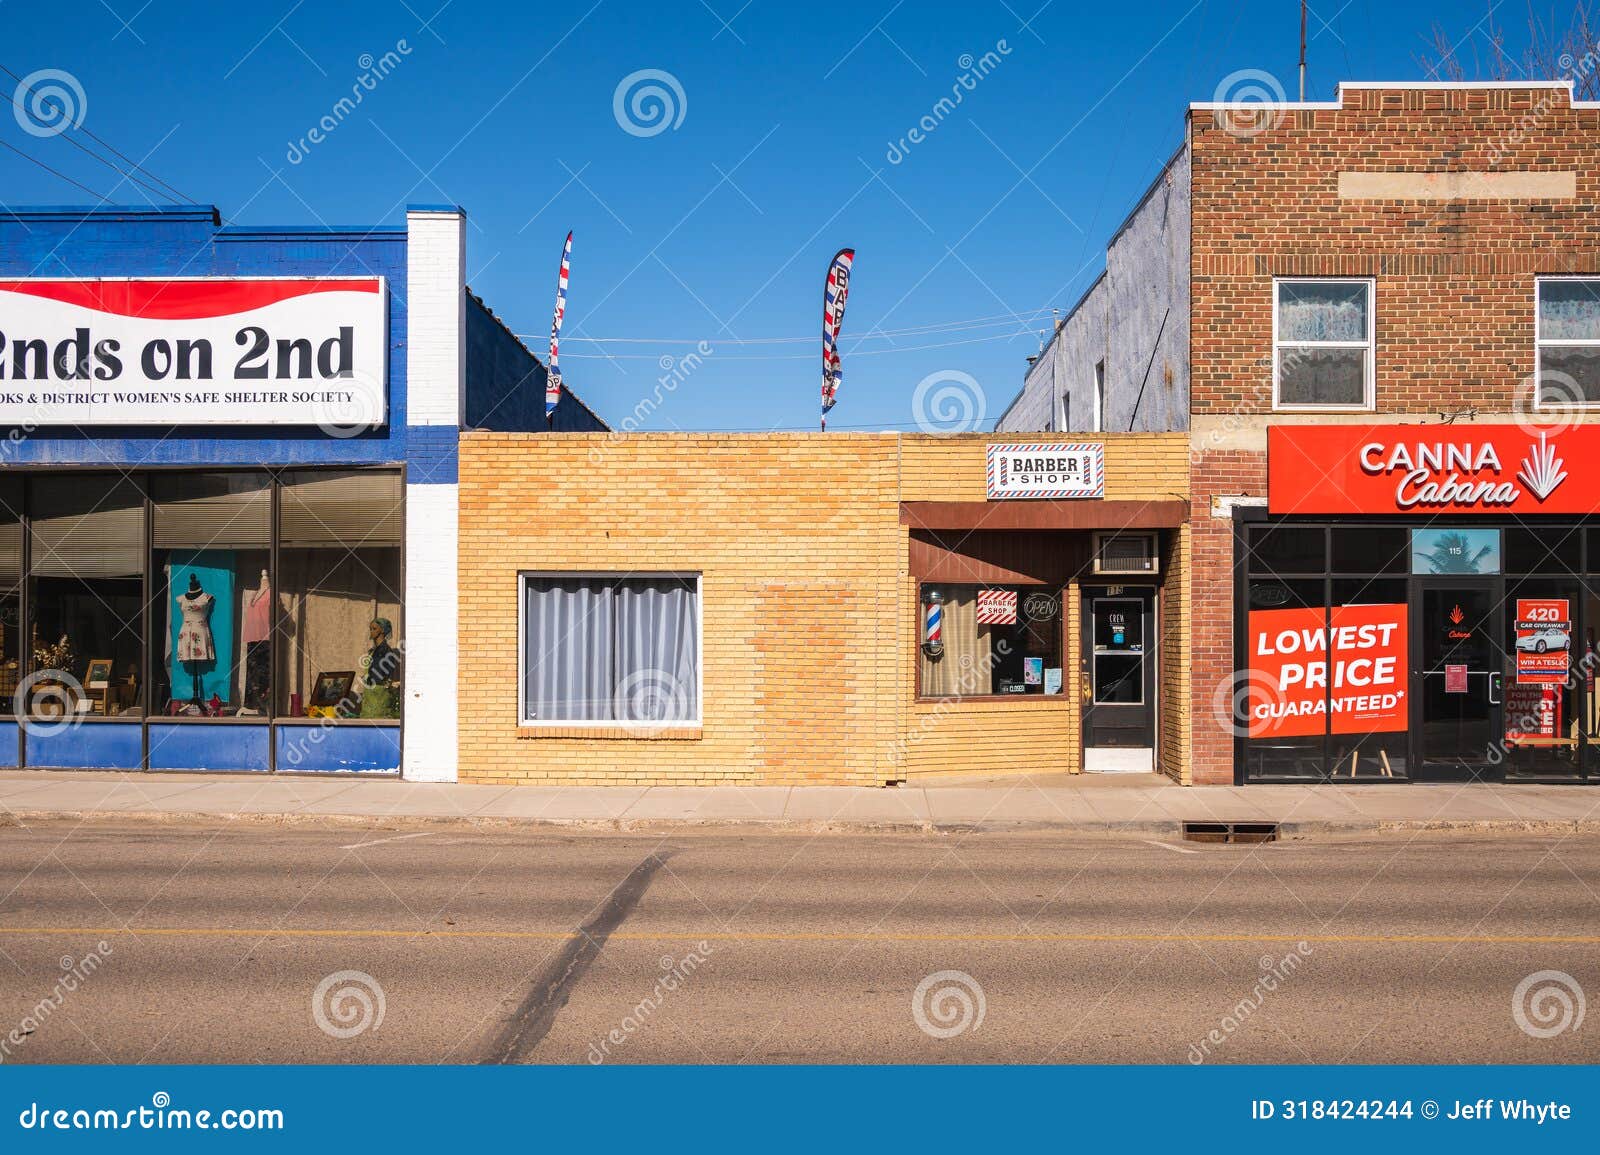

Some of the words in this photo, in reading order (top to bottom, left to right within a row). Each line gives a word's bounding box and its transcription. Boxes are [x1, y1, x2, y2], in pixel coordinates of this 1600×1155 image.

[0, 324, 122, 381] nds
[141, 338, 213, 381] on
[234, 326, 354, 380] 2nd
[26, 393, 38, 404] &
[42, 393, 110, 404] DISTRICT
[113, 392, 181, 404] WOMEN'S
[184, 392, 220, 403] SAFE
[224, 392, 289, 403] SHELTER
[292, 391, 354, 403] SOCIETY
[1012, 457, 1078, 473] BARBER
[1359, 442, 1502, 473] CANNA
[1020, 474, 1071, 484] SHOP
[1396, 469, 1520, 507] Cabana
[1448, 547, 1462, 556] 115
[983, 599, 1013, 607] BARBER
[1026, 600, 1055, 615] OPEN
[1526, 608, 1560, 621] 420
[1257, 623, 1398, 656] LOWEST
[1279, 656, 1396, 692] PRICE
